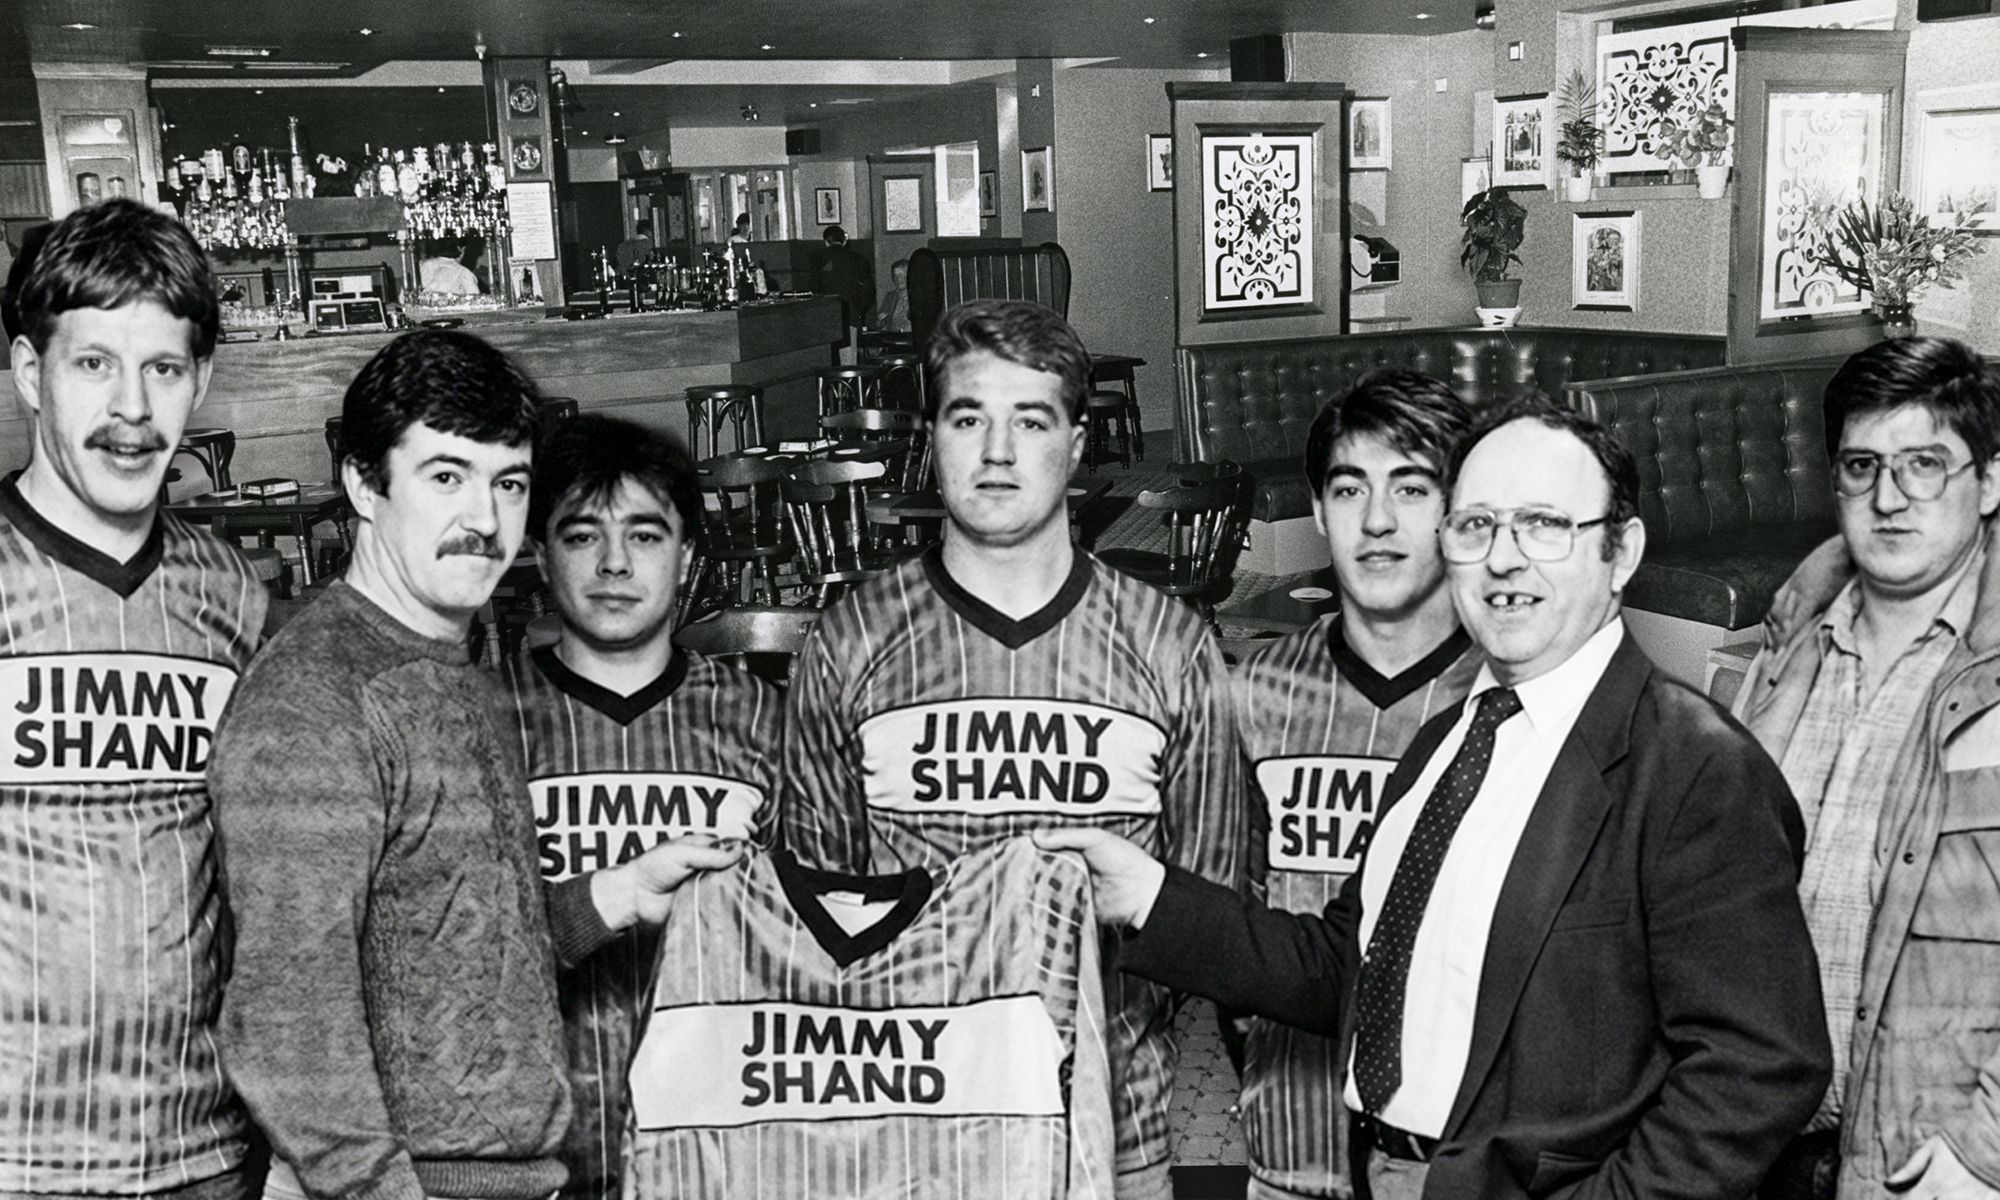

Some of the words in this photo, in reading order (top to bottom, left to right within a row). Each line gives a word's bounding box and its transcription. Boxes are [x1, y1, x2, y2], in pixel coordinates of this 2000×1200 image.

[15, 667, 208, 719] JIMMY
[14, 719, 213, 772] SHAND
[912, 710, 1113, 757] JIMMY
[911, 758, 1110, 803] SHAND
[535, 785, 728, 828] JIMMY
[742, 1011, 949, 1060] JIMMY
[741, 1060, 945, 1107] SHAND
